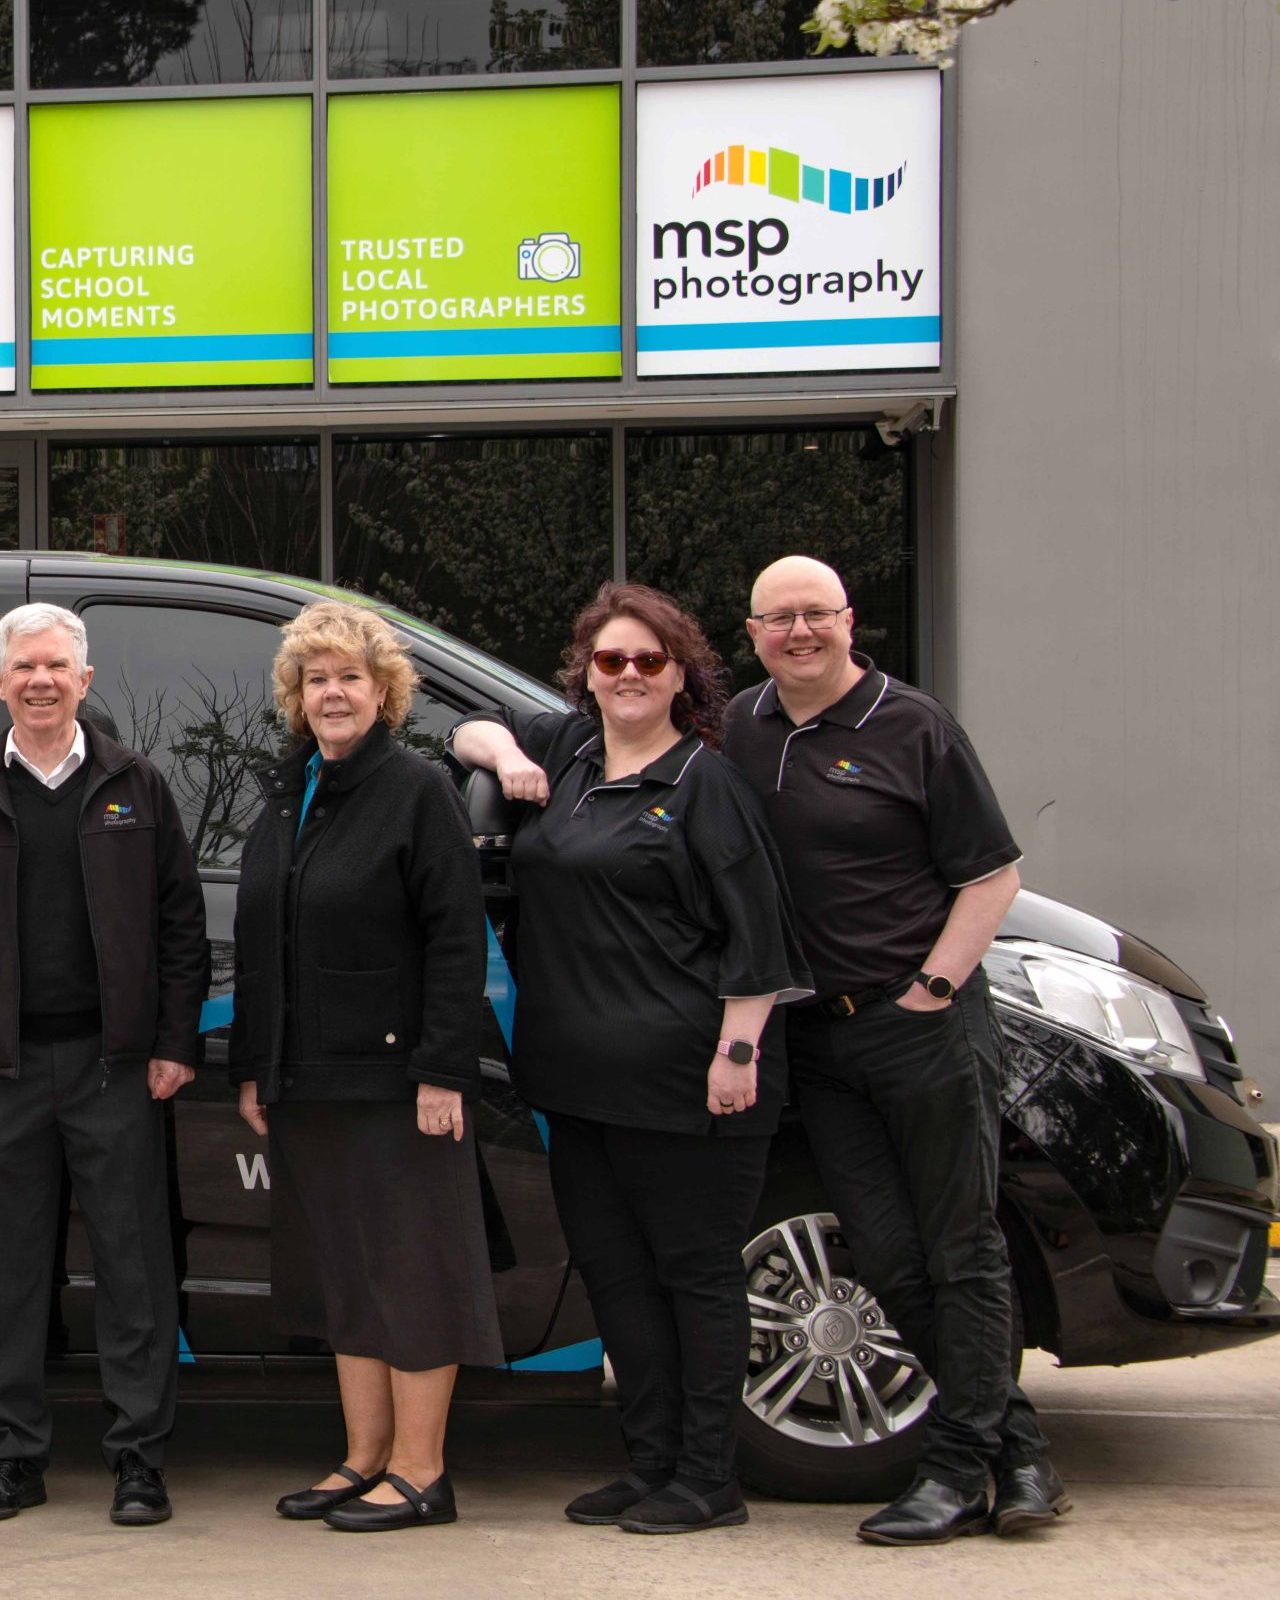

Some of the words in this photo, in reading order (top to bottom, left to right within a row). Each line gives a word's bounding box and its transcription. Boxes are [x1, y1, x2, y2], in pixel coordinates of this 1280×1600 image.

[40, 243, 195, 270] CAPTURING
[341, 236, 465, 262] TRUSTED
[654, 217, 790, 272] msp
[40, 275, 150, 299] SCHOOL
[342, 267, 429, 292] LOCAL
[654, 259, 924, 310] photography
[41, 304, 177, 329] MOMENTS
[342, 293, 587, 322] PHOTOGRAPHERS
